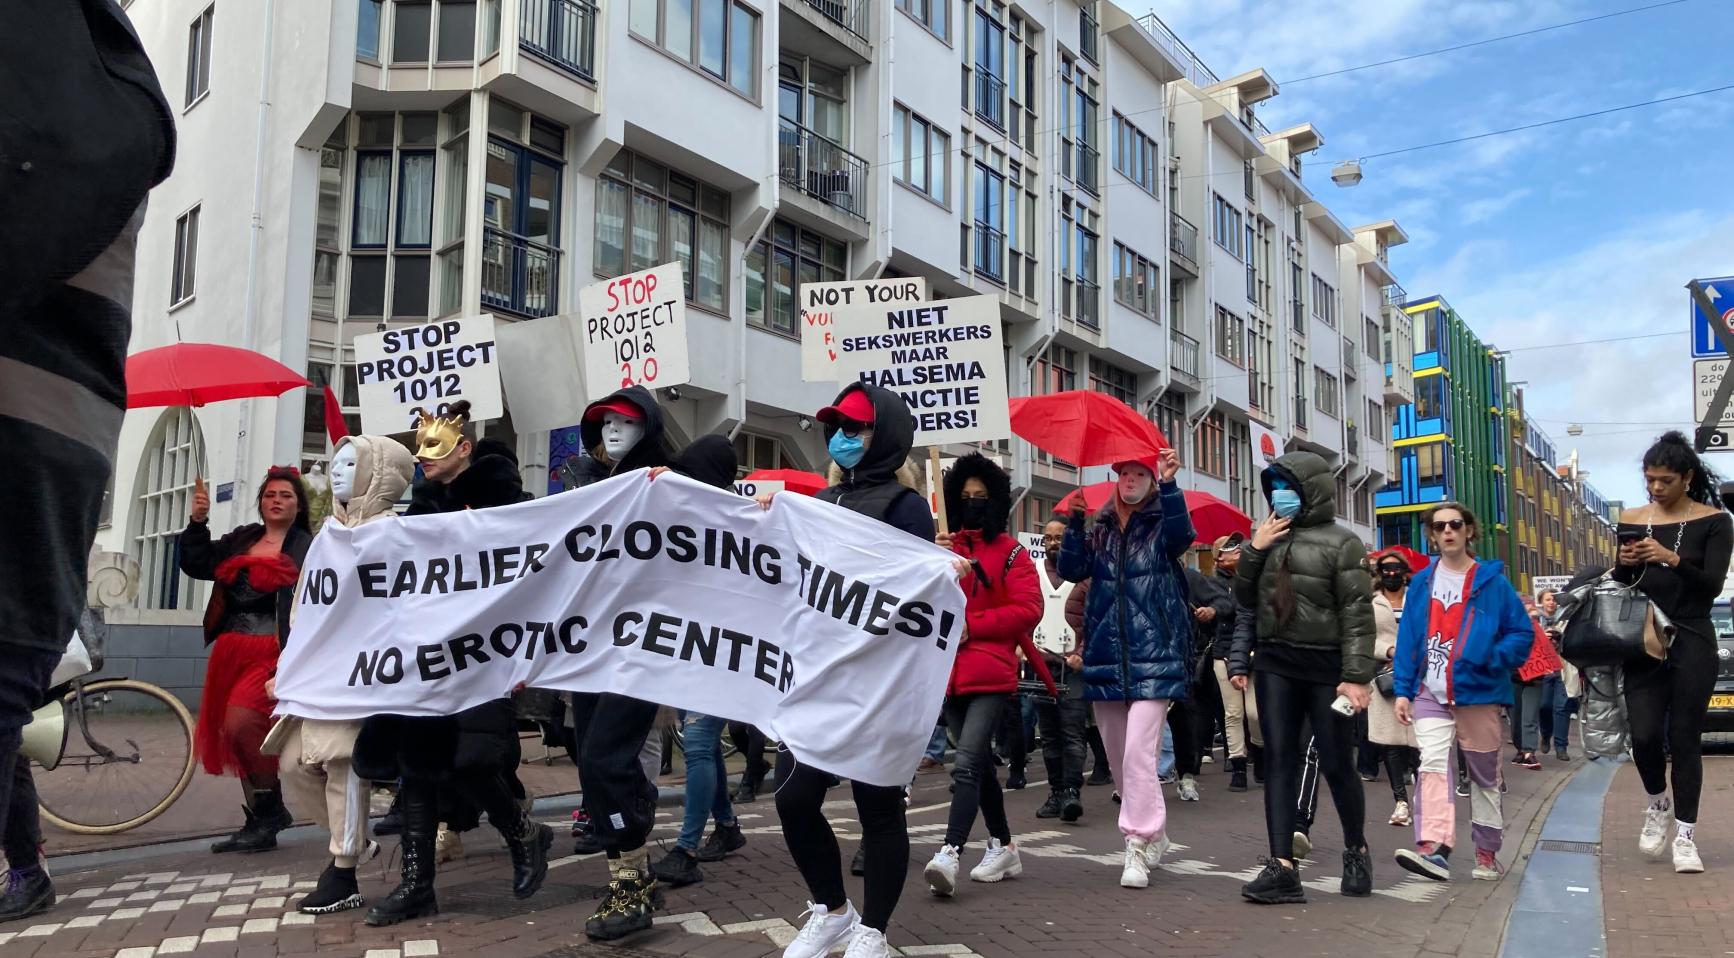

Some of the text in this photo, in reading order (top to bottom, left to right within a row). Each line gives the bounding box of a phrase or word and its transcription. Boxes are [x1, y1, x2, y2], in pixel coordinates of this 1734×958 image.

[608, 274, 657, 312] STOP
[809, 283, 920, 307] NOT YOUR
[588, 300, 677, 344] PROJECT
[887, 306, 948, 330] NIET
[383, 321, 461, 354] STOP
[615, 331, 656, 364] 1012
[842, 325, 992, 352] SEKSWERKERS
[358, 341, 495, 384] PROJECT
[891, 346, 949, 364] MAAR
[393, 373, 462, 404] 1012
[621, 357, 658, 389] 2.0
[859, 361, 986, 388] HALSEMA
[900, 386, 980, 409] NCTIE
[734, 483, 757, 497] NO
[1028, 549, 1046, 559] OT
[302, 520, 955, 651] NO EARLIER CLOSING TIMES!
[348, 611, 796, 694] NO EROTIC CENTER
